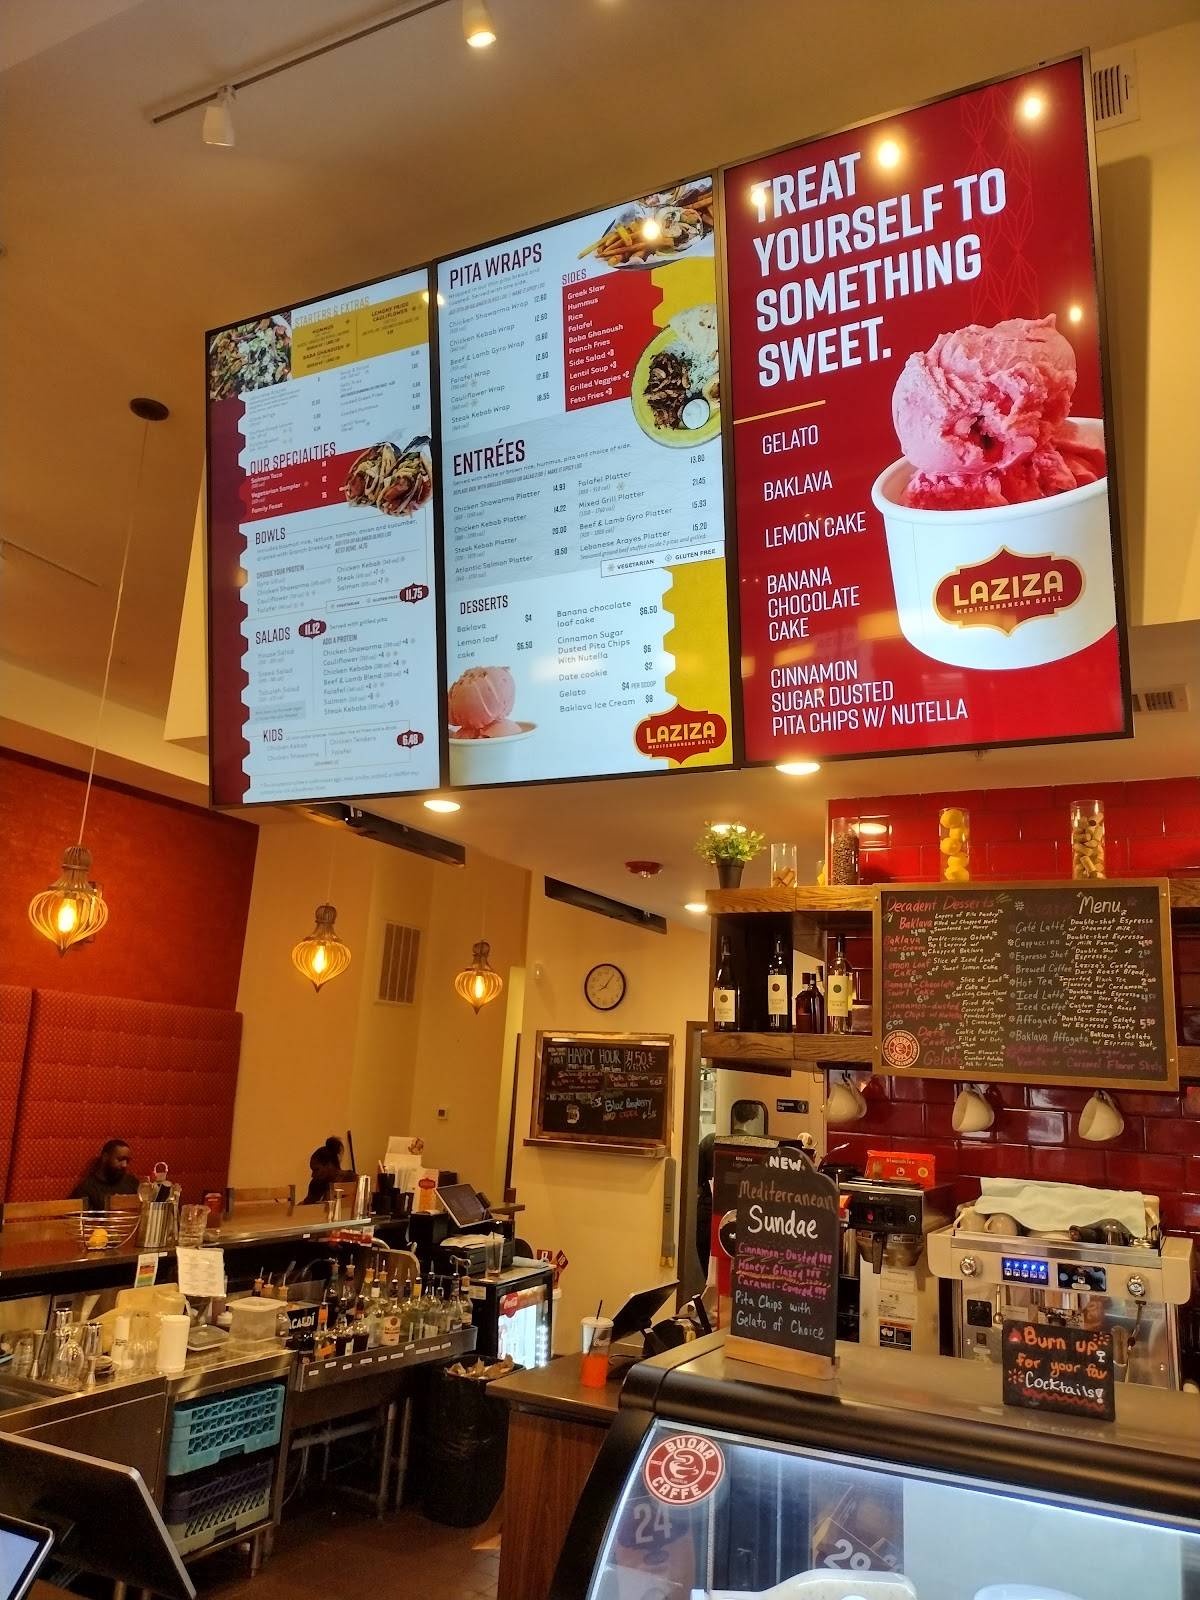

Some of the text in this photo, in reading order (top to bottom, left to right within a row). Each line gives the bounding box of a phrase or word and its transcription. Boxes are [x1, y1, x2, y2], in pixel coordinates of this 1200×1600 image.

[751, 151, 861, 223] TREAT
[753, 168, 1007, 276] YOURSELF TO
[450, 262, 482, 290] PITA
[486, 242, 542, 279] WRAPS
[562, 269, 586, 285] SIDES
[756, 234, 982, 332] SOMETHING
[568, 284, 606, 300] Greek Slaw
[568, 298, 598, 310] Hummus
[568, 312, 584, 322] Rice
[450, 335, 475, 347] Chicken
[476, 329, 497, 340] Kebab
[498, 323, 515, 334] Wrap
[568, 320, 592, 333] Falafel
[568, 324, 624, 344] Baba Ghanoush
[450, 356, 466, 366] Beef
[472, 350, 490, 360] Lamb
[491, 345, 507, 356] Gyro
[508, 340, 525, 351] Wrap
[568, 339, 610, 354] French Fries
[758, 316, 892, 388] SWEET.
[762, 425, 819, 455] GELATO
[250, 442, 336, 474] OUR SPECIALTIES
[454, 438, 525, 476] ENTRÉES
[764, 470, 832, 502] BAKLAVA
[579, 500, 600, 508] Mixed
[602, 496, 617, 504] Grill
[618, 490, 645, 501] Platter
[580, 521, 596, 530] Beef
[604, 516, 624, 526] Lamb
[626, 512, 644, 523] Gyro
[645, 508, 672, 518] Platter
[256, 528, 286, 545] BOWLS
[765, 511, 866, 548] LEMON CAKE
[675, 548, 716, 560] GLUTEN FREE
[617, 560, 654, 570] VEGETARIAN
[337, 575, 354, 583] Steak
[767, 566, 832, 595] BANANA
[406, 588, 422, 600] 11.75
[953, 570, 1064, 607] LAZIZA
[460, 594, 509, 615] DESSERTS
[557, 600, 658, 618] Banana chocolate $6.50
[768, 586, 860, 618] CHOCOLATE
[304, 622, 320, 636] 11.12
[557, 616, 595, 628] loaf cake
[768, 618, 810, 642] CAKE
[256, 626, 290, 644] SALADS
[457, 634, 498, 647] Lemon loaf
[558, 629, 624, 644] Cinnamon Sugar
[458, 641, 533, 659] cake $6.50
[770, 660, 858, 689] CINNAMON
[772, 681, 894, 712] SUGAR DUSTED
[773, 698, 968, 736] PITA CHIPS W/ NUTELLA
[263, 728, 283, 742] KIDS
[646, 721, 716, 744] LAZIZA
[887, 896, 994, 912] Decadent Desserts
[1078, 896, 1120, 914] Menu
[900, 916, 932, 930] Baklava
[1120, 916, 1154, 925] Espresso
[1014, 938, 1060, 948] Cappuccino
[1015, 950, 1068, 962] Espresso Shot
[1016, 963, 1073, 974] Brewed Coffee
[1016, 977, 1053, 988] Hot Tea
[1016, 1002, 1066, 1012] Iced Coffee
[1016, 1014, 1058, 1028] Affogato
[1112, 1016, 1136, 1024] Gelato
[1016, 1030, 1089, 1046] Baklava Affogato
[1090, 1031, 1115, 1039] Baklava
[568, 1048, 594, 1064] HAPPY
[768, 1156, 802, 1172] NEW
[738, 1180, 834, 1211] Mediterranean
[748, 1204, 818, 1239] Sundae
[736, 1290, 812, 1315] Pita Chips with
[736, 1310, 824, 1340] Gelato of Choice
[1024, 1326, 1098, 1356] Burn up
[1016, 1352, 1108, 1380] for your fav
[664, 1438, 716, 1460] BUONA
[652, 1476, 702, 1500] CAFFE
[633, 1502, 672, 1545] 24
